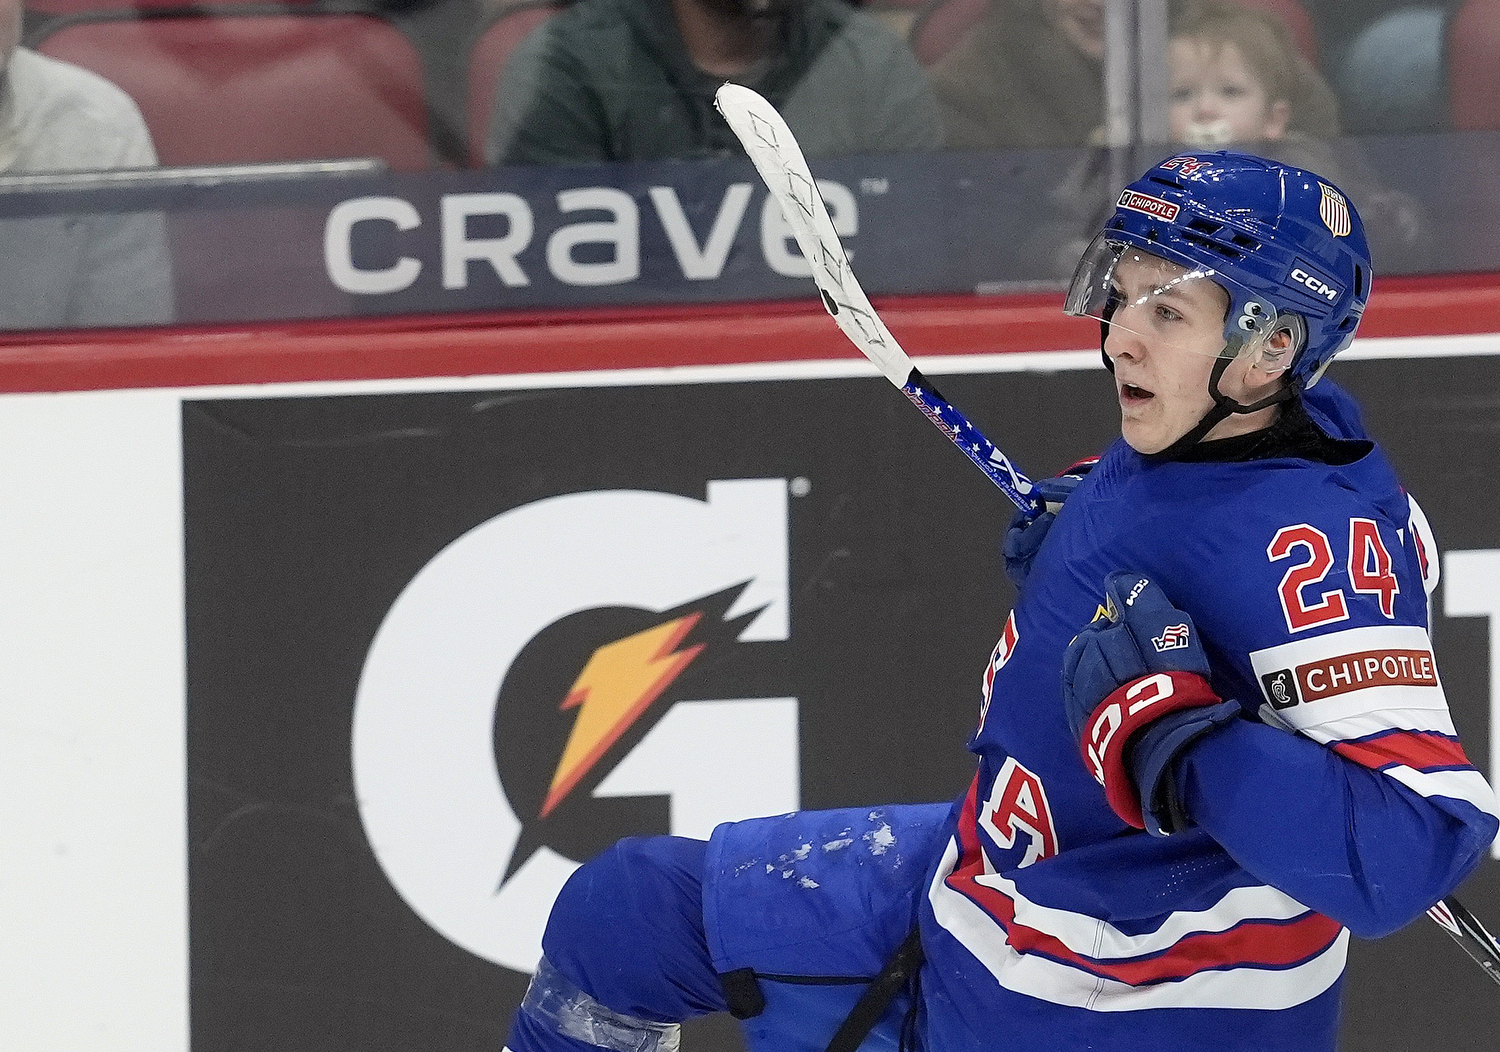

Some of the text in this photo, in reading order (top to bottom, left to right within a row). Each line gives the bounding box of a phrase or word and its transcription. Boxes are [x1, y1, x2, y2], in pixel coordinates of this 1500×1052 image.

[1130, 196, 1177, 219] CHIPOTLE
[1290, 267, 1338, 301] CCM
[1266, 517, 1400, 634] 24
[1306, 654, 1434, 693] CHIPOTLE
